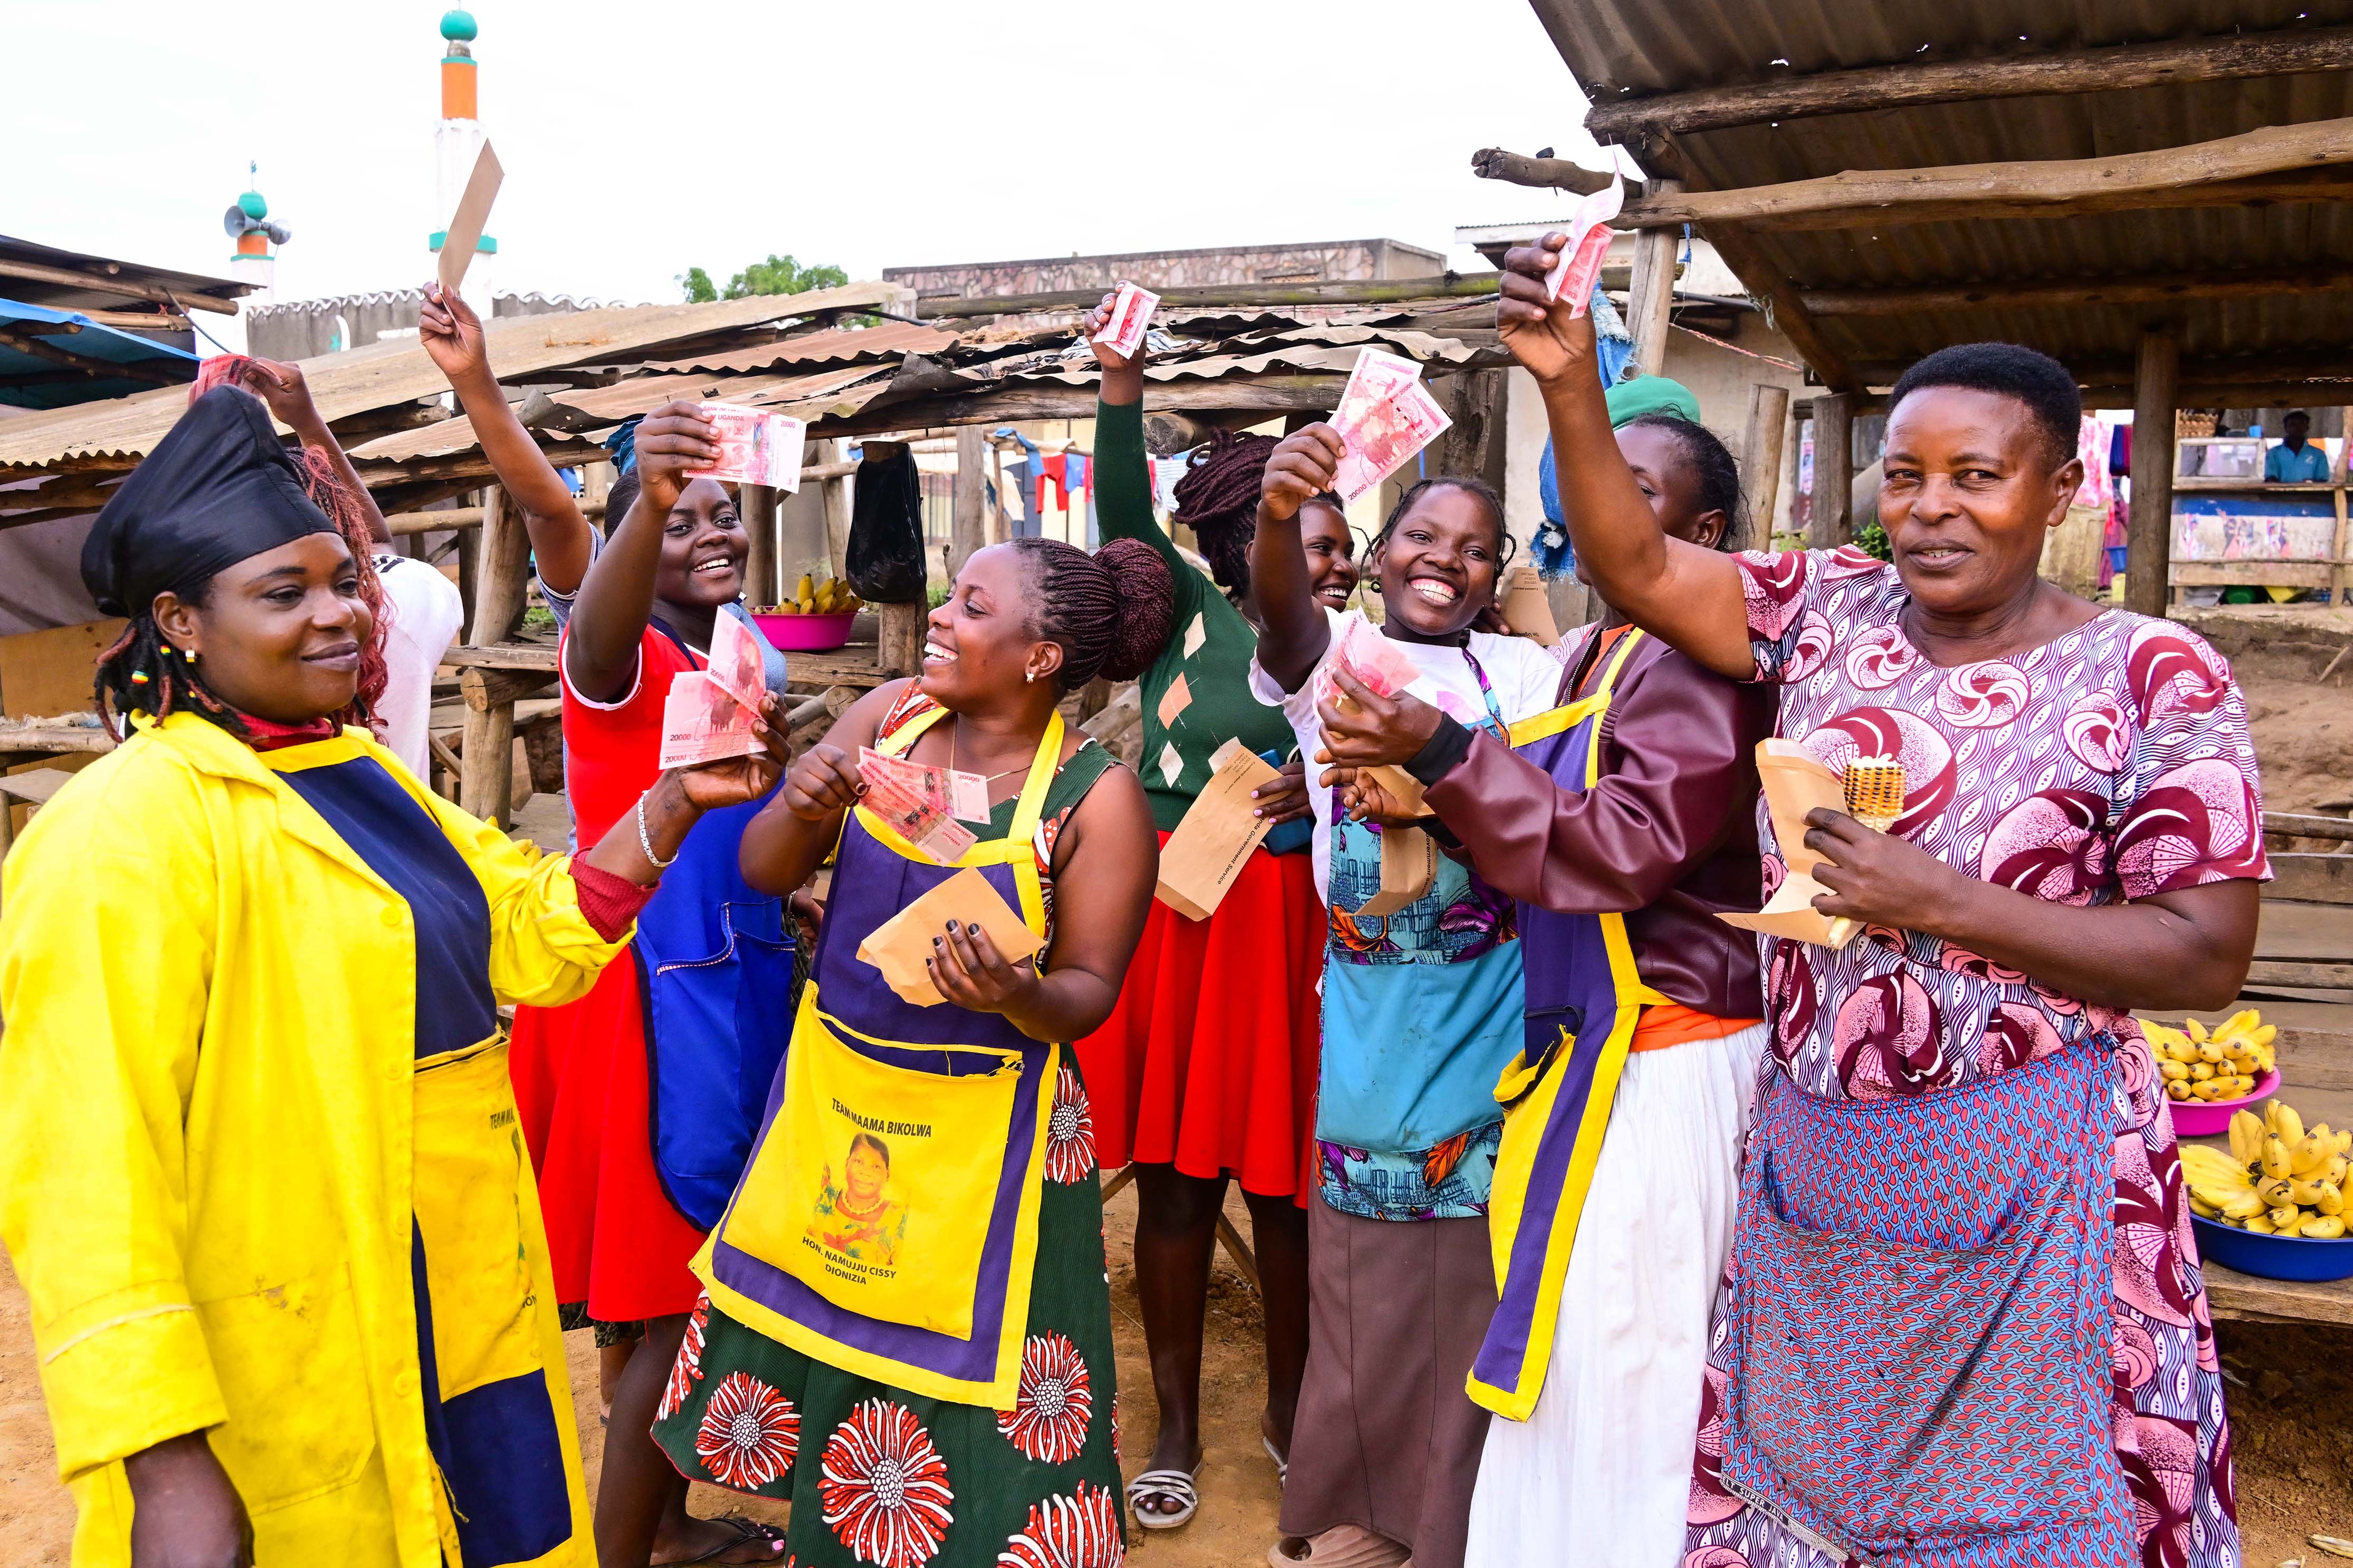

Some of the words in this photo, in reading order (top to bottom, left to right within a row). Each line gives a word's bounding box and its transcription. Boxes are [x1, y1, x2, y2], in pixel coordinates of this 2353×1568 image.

[1361, 353, 1370, 368] 20000
[1399, 382, 1414, 395] 20000
[1348, 484, 1367, 501] 20000
[710, 668, 725, 683] 20000
[861, 766, 875, 781] BANK
[883, 785, 906, 804] UGANDA
[867, 761, 882, 777] BANK
[891, 780, 913, 798] UGANDA
[958, 774, 980, 782] 20000
[950, 823, 971, 838] 20000
[1254, 817, 1266, 830] anda
[941, 831, 961, 847] 20000
[1231, 830, 1255, 864] Government
[1217, 864, 1233, 885] Service
[490, 1110, 506, 1130] TEAM
[506, 1107, 516, 1124] MA
[832, 1097, 851, 1120] TEAM
[851, 1111, 884, 1133] MAAMA
[887, 1121, 931, 1137] BIKOLWA
[802, 1236, 823, 1256] HON.
[824, 1250, 868, 1273] NAMUJJU
[869, 1267, 897, 1279] CISSY
[825, 1264, 866, 1285] DIONIZIA
[1739, 1487, 1765, 1507] SUPER
[1768, 1505, 1784, 1521] JAVA
